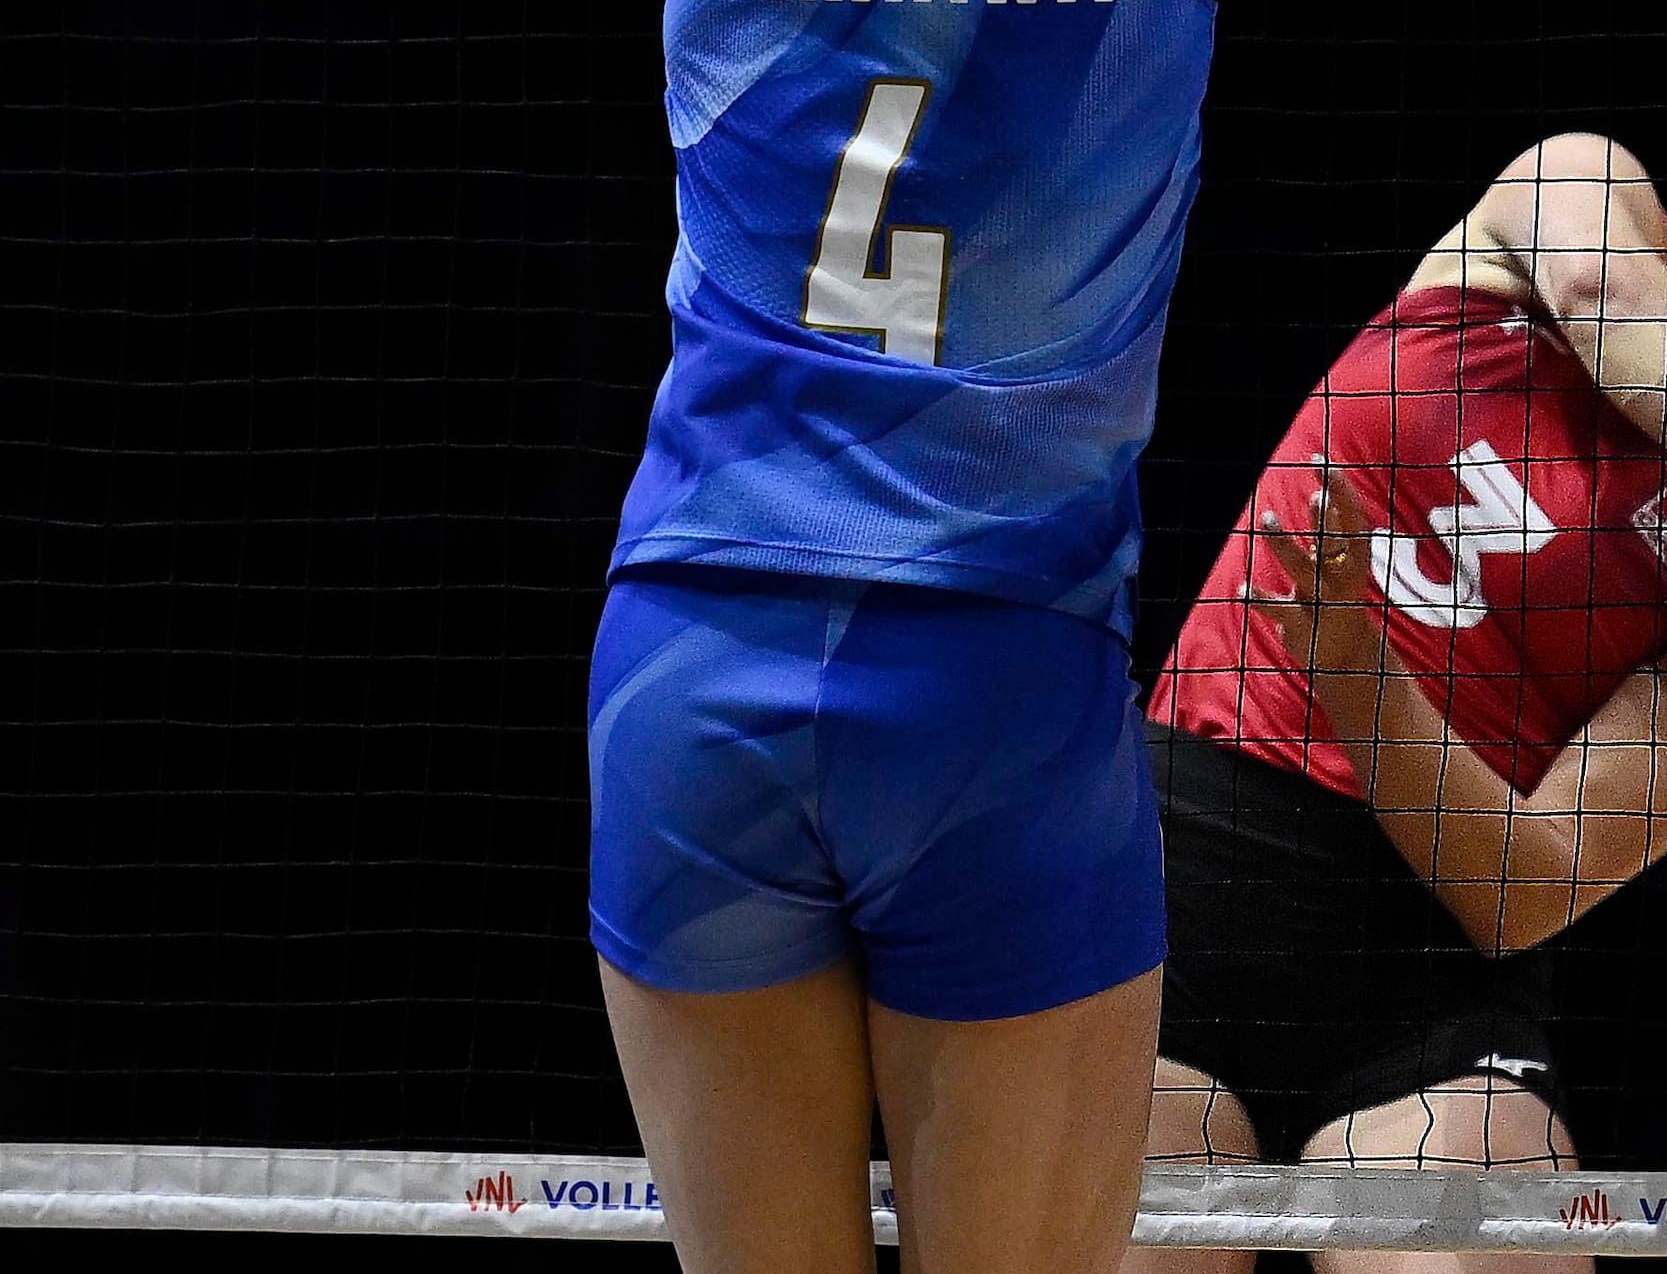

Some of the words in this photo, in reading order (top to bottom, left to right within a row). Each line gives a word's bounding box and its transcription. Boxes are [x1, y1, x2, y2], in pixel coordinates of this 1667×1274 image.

[803, 79, 949, 367] 4
[1371, 439, 1557, 628] 3
[466, 1171, 528, 1213] VNL
[1559, 1189, 1622, 1231] VNL
